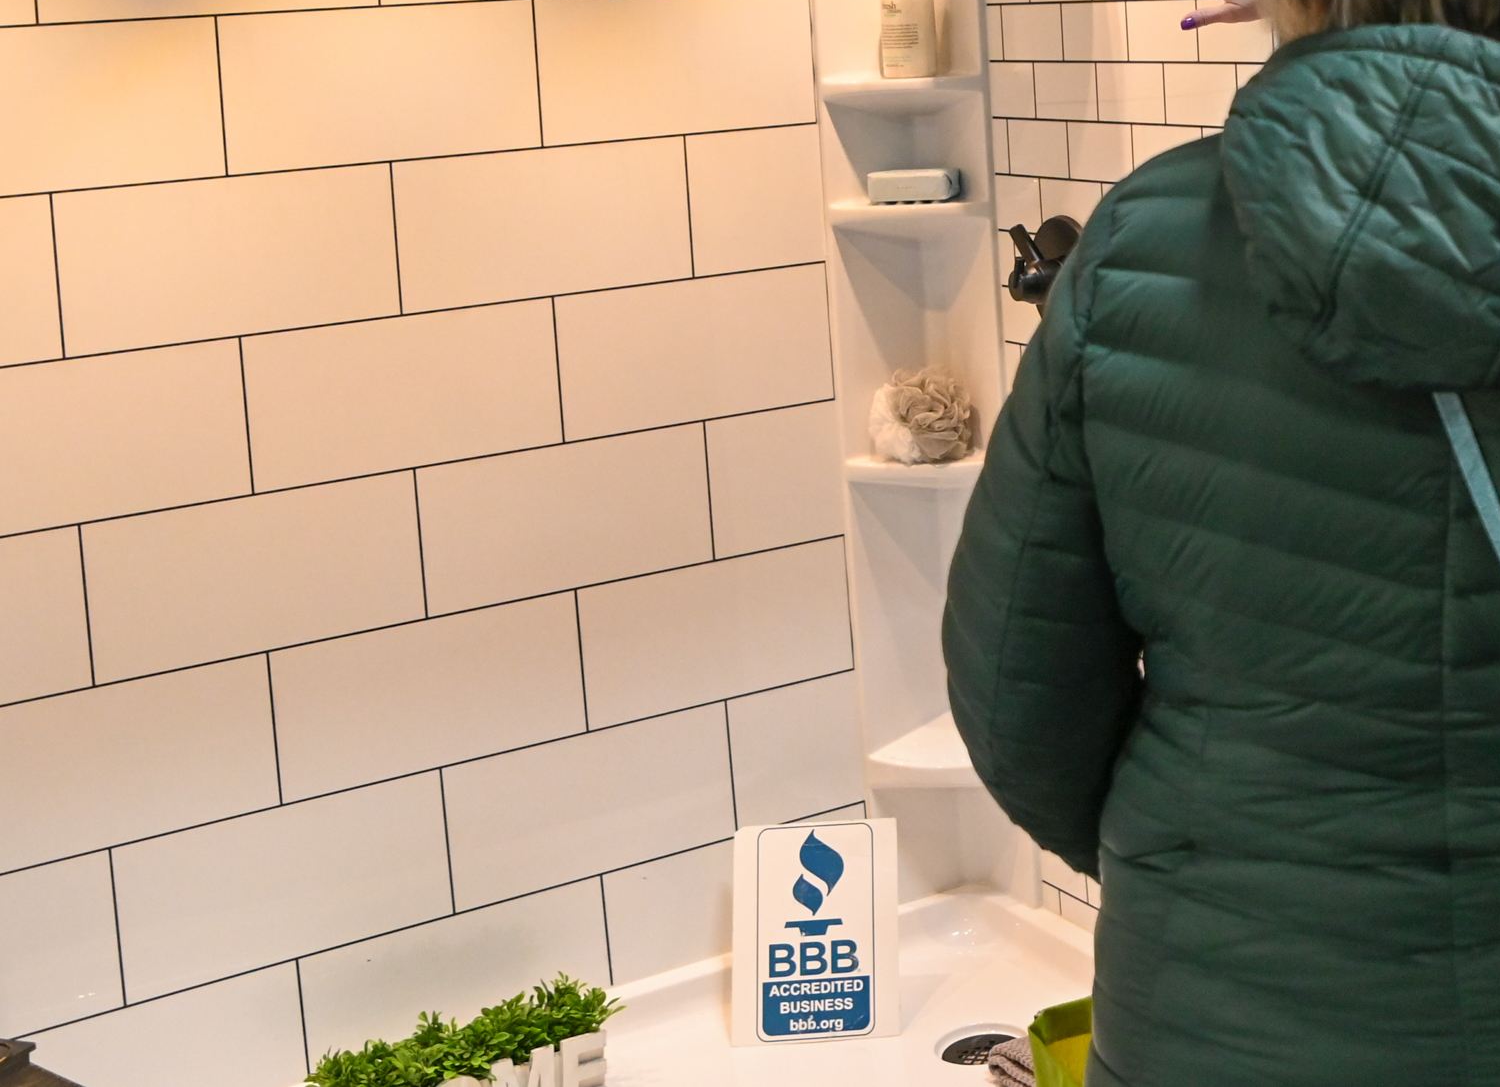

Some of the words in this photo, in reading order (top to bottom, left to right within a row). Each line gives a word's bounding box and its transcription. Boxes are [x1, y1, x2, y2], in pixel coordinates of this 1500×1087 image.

[768, 939, 860, 978] BBB
[769, 979, 864, 997] ACCREDITED
[780, 997, 853, 1014] BUSINESS
[789, 1017, 844, 1031] bbb.org
